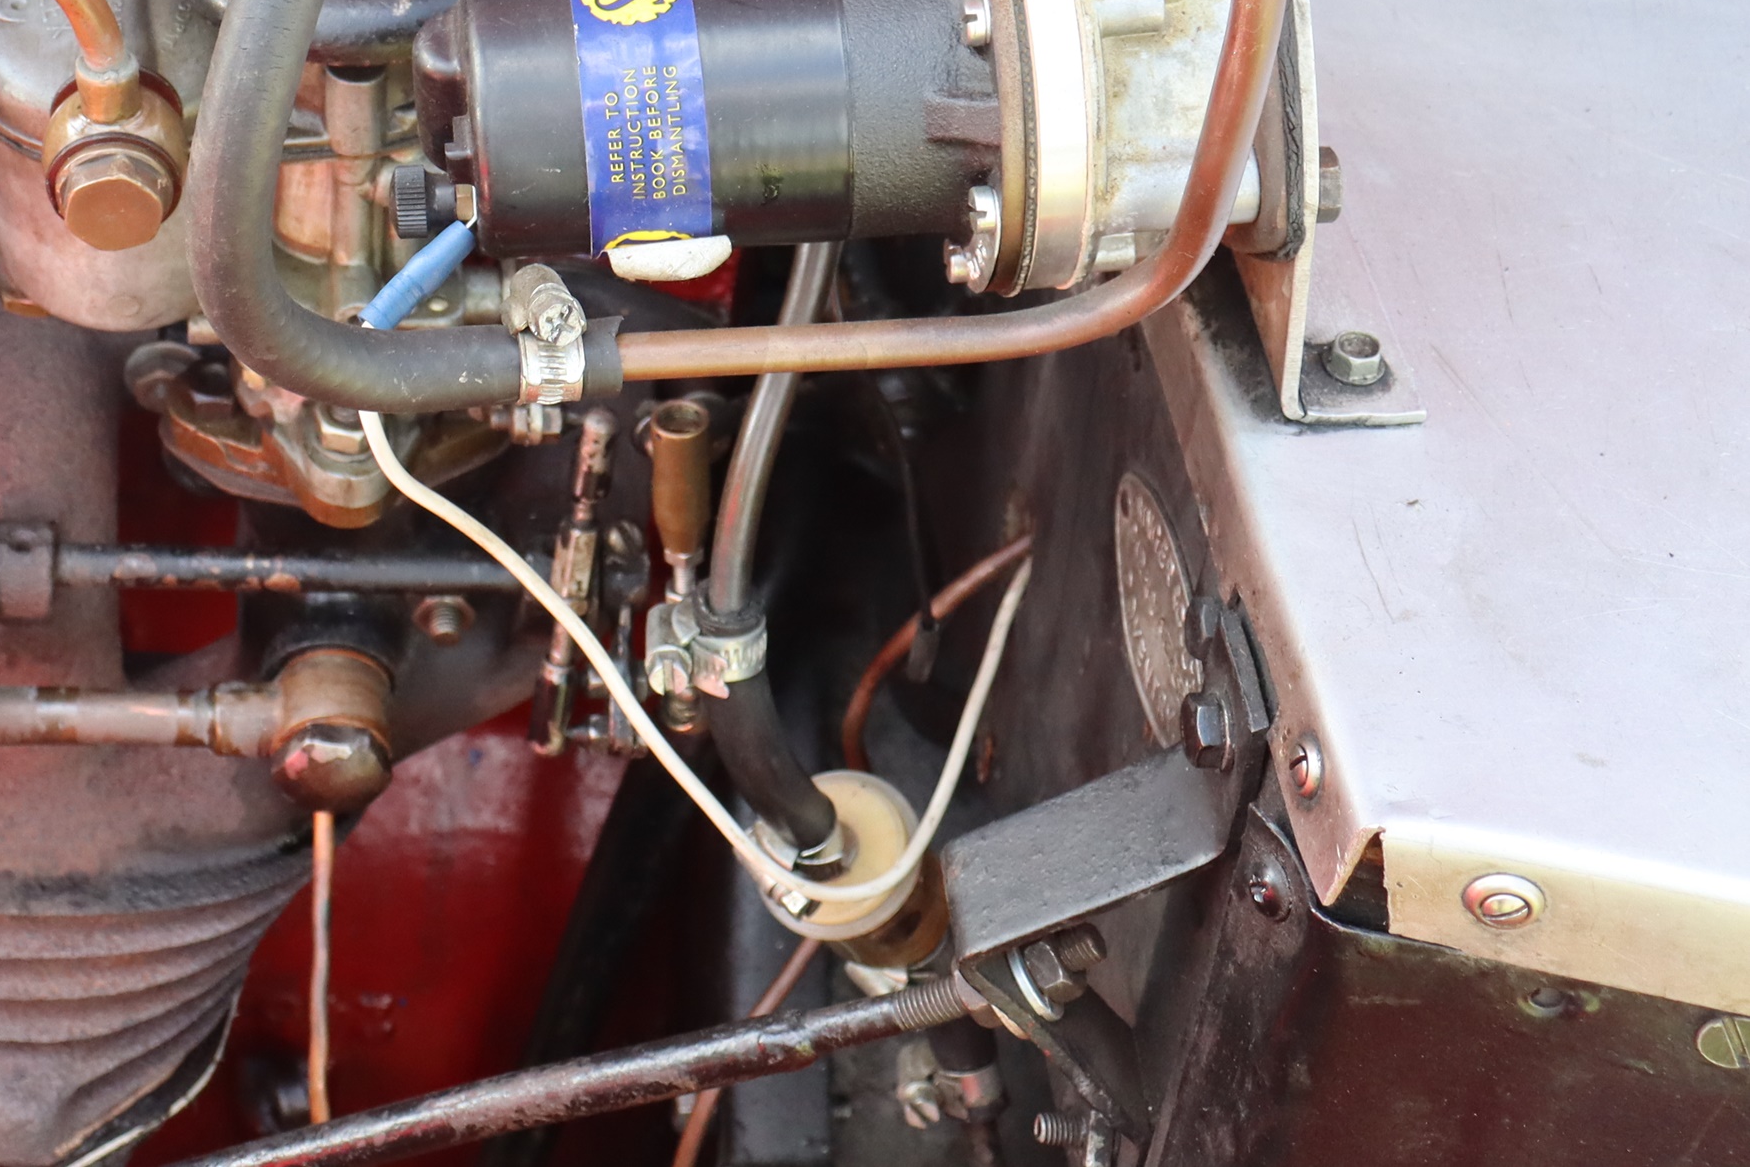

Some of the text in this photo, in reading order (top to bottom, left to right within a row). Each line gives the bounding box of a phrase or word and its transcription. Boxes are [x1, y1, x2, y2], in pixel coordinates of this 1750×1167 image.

[605, 91, 624, 183] REFER TO
[624, 68, 647, 200] INSTRUCTION
[643, 65, 666, 200] BOOK BEFORE
[664, 65, 687, 196] DISMANTLING
